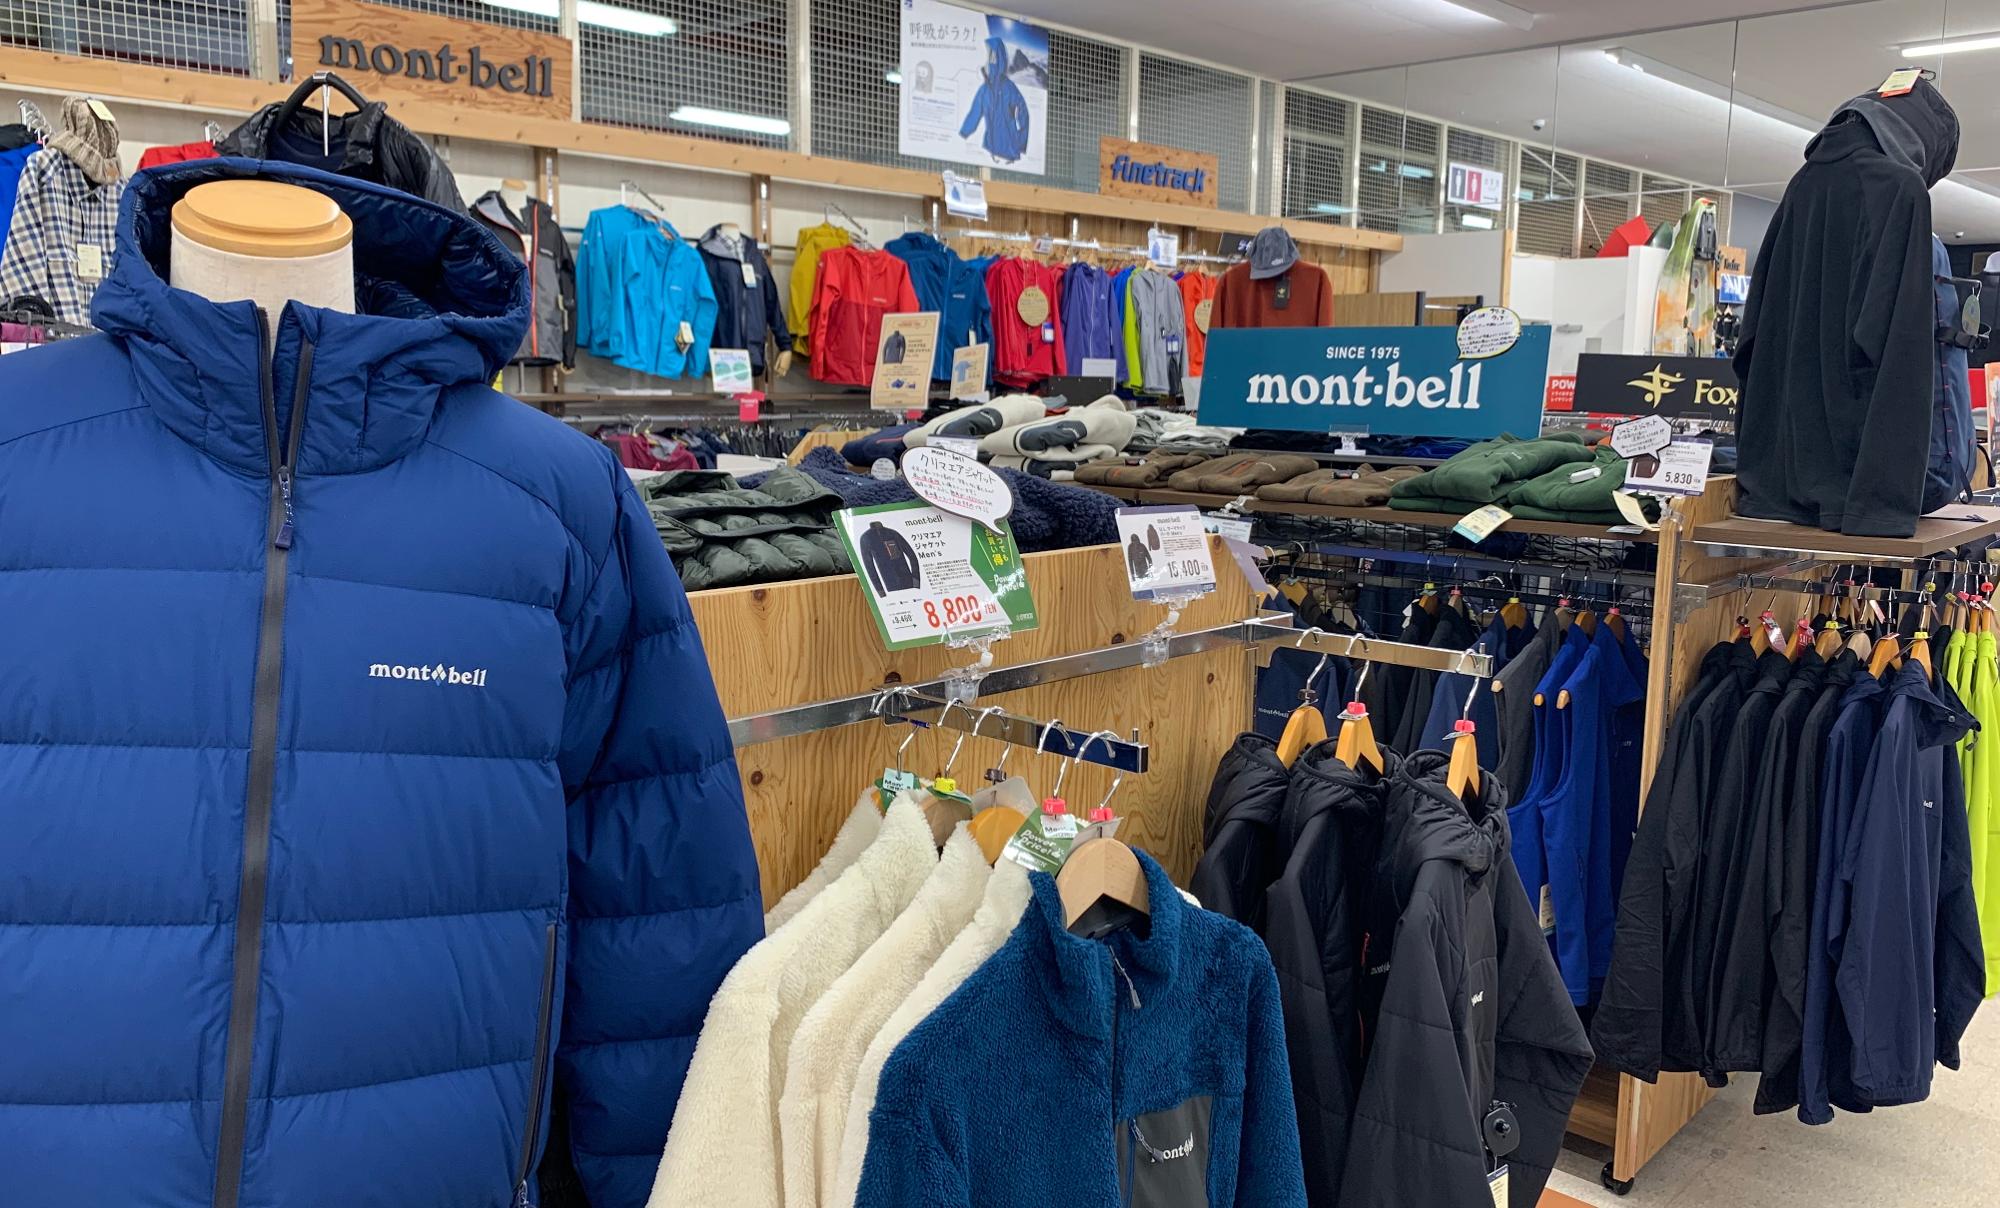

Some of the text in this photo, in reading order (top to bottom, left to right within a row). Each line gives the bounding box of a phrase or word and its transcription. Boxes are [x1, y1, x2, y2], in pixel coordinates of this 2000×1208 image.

[1111, 154, 1206, 193] finetrack
[1326, 346, 1400, 359] SINCE 1975
[911, 530, 942, 542] クリマエア
[914, 540, 946, 550] ジャケット
[918, 550, 943, 559] Men's
[923, 594, 983, 629] 8,800
[949, 783, 954, 792] S
[1045, 804, 1054, 814] M
[1020, 829, 1057, 848] Power
